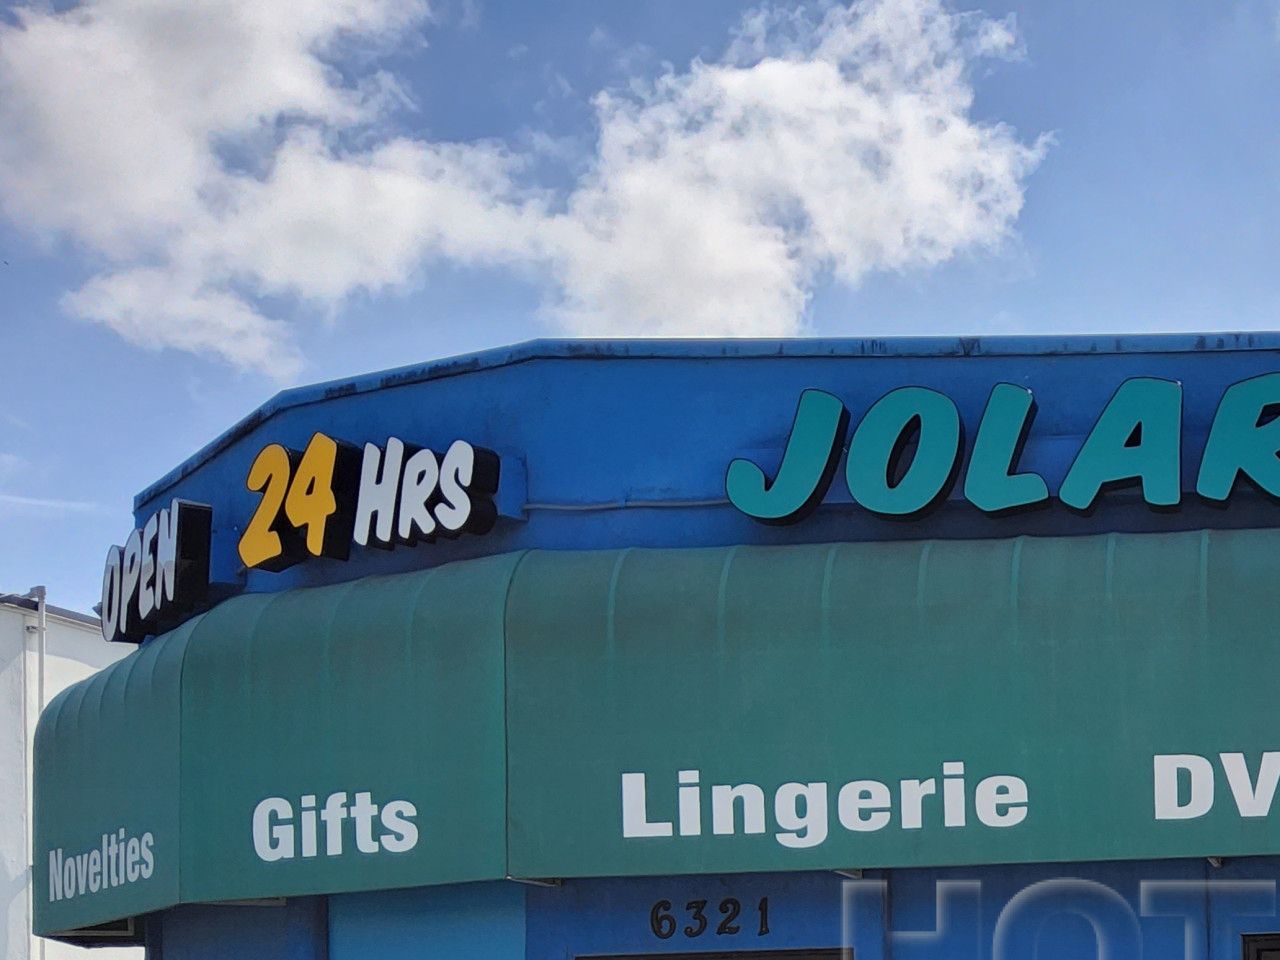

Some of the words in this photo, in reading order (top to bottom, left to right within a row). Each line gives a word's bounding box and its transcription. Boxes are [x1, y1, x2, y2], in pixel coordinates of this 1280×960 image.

[237, 431, 338, 570] 24
[353, 436, 474, 546] HRS
[102, 499, 178, 642] OPEN
[251, 791, 419, 862] Gifts
[621, 761, 1029, 849] Lingerie
[48, 828, 154, 902] Novelties
[650, 896, 770, 939] 6321
